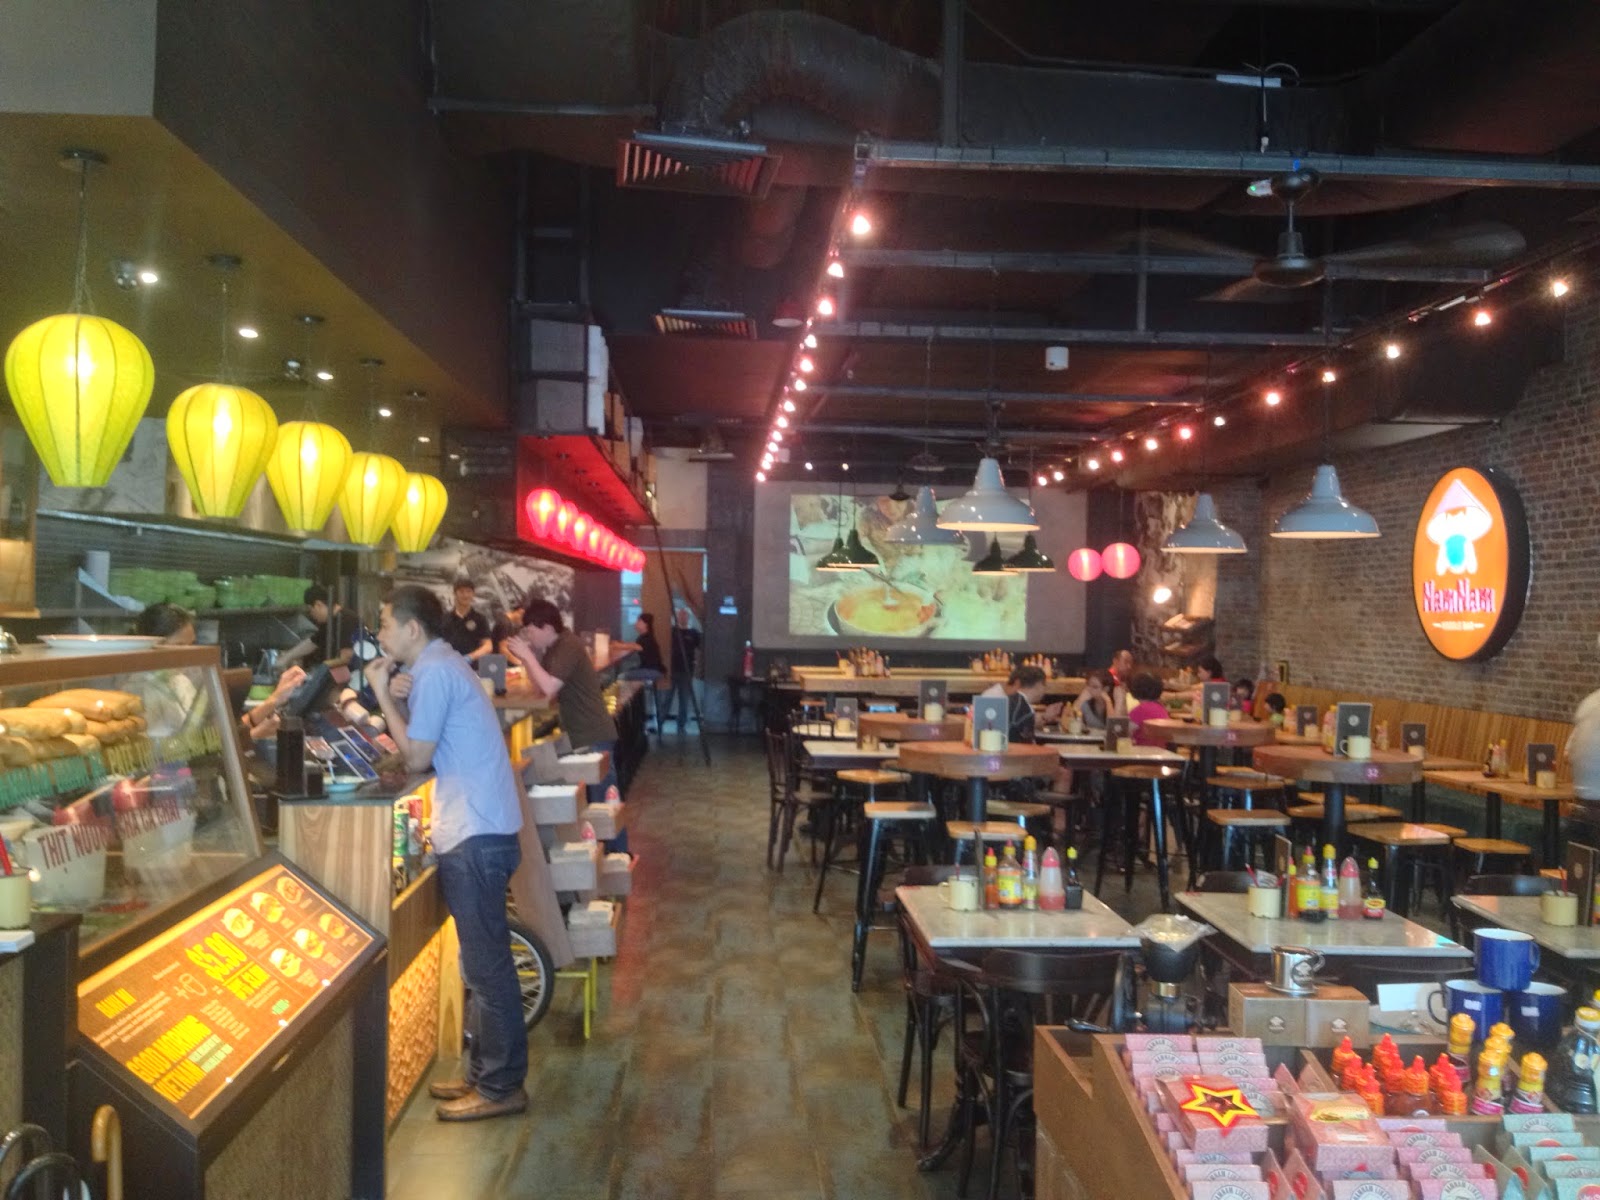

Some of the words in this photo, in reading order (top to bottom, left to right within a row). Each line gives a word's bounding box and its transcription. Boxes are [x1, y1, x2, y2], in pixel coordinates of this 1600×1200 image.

[185, 931, 248, 982] $5.90
[125, 1047, 172, 1085] GOOD
[153, 1058, 207, 1103] VIETNAM
